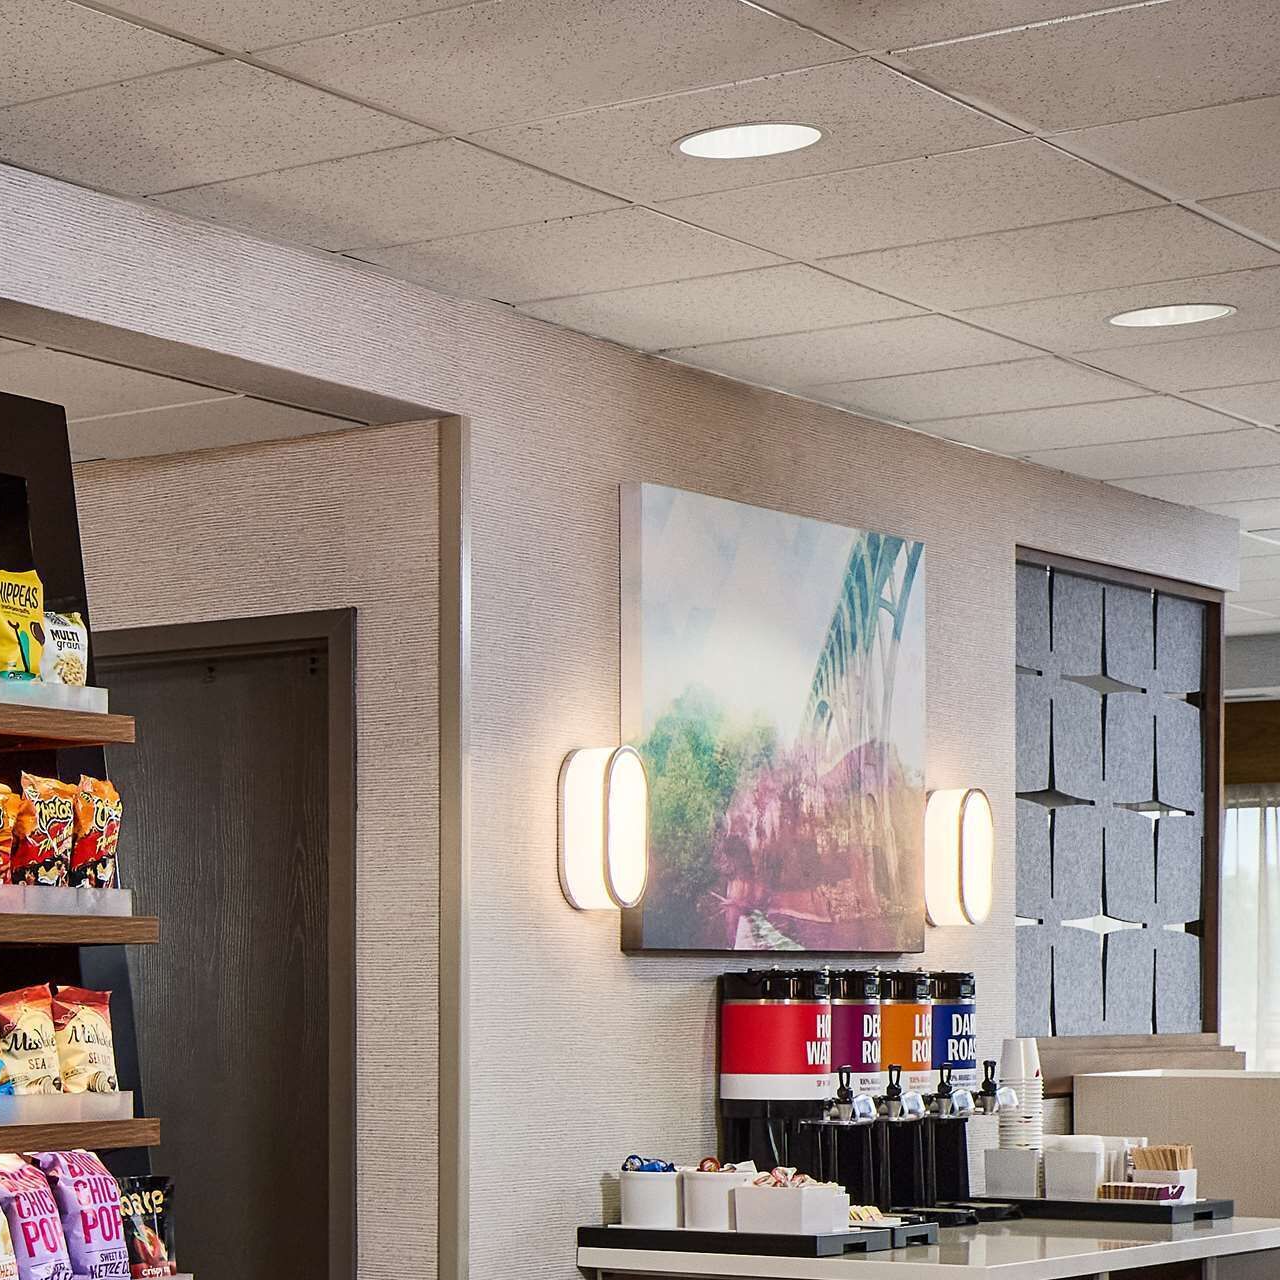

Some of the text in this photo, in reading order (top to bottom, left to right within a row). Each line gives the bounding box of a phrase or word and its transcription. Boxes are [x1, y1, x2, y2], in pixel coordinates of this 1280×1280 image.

[50, 628, 80, 643] MULTI
[816, 1014, 831, 1038] HO
[952, 1013, 976, 1036] DAR
[806, 1041, 831, 1066] WAT
[947, 1038, 976, 1061] ROAS
[28, 1057, 47, 1070] SEA
[73, 1177, 119, 1206] CHIC
[14, 1190, 56, 1220] CHIC
[80, 1205, 123, 1245] POP
[99, 1251, 118, 1262] SWEET
